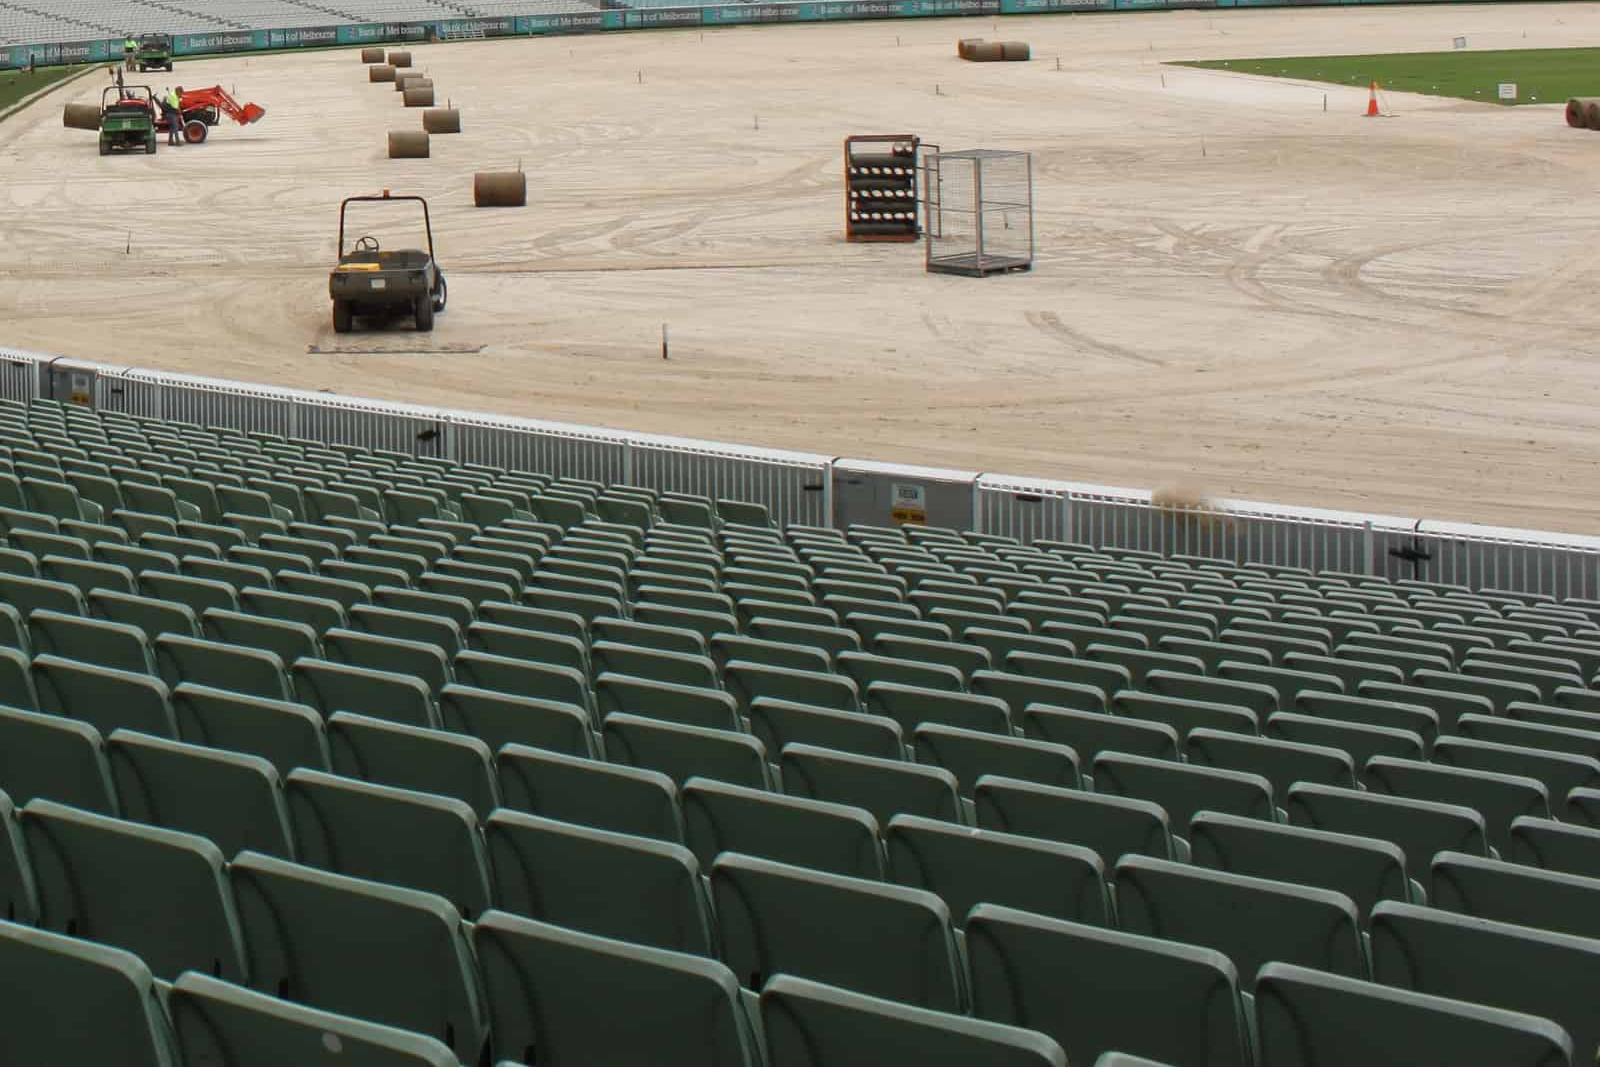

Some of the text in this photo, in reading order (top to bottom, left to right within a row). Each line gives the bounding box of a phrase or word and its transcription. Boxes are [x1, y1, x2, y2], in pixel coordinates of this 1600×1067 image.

[531, 19, 550, 28] Bank
[560, 16, 602, 26] Melbourne
[190, 37, 207, 47] Bank
[216, 35, 253, 45] Melbourne
